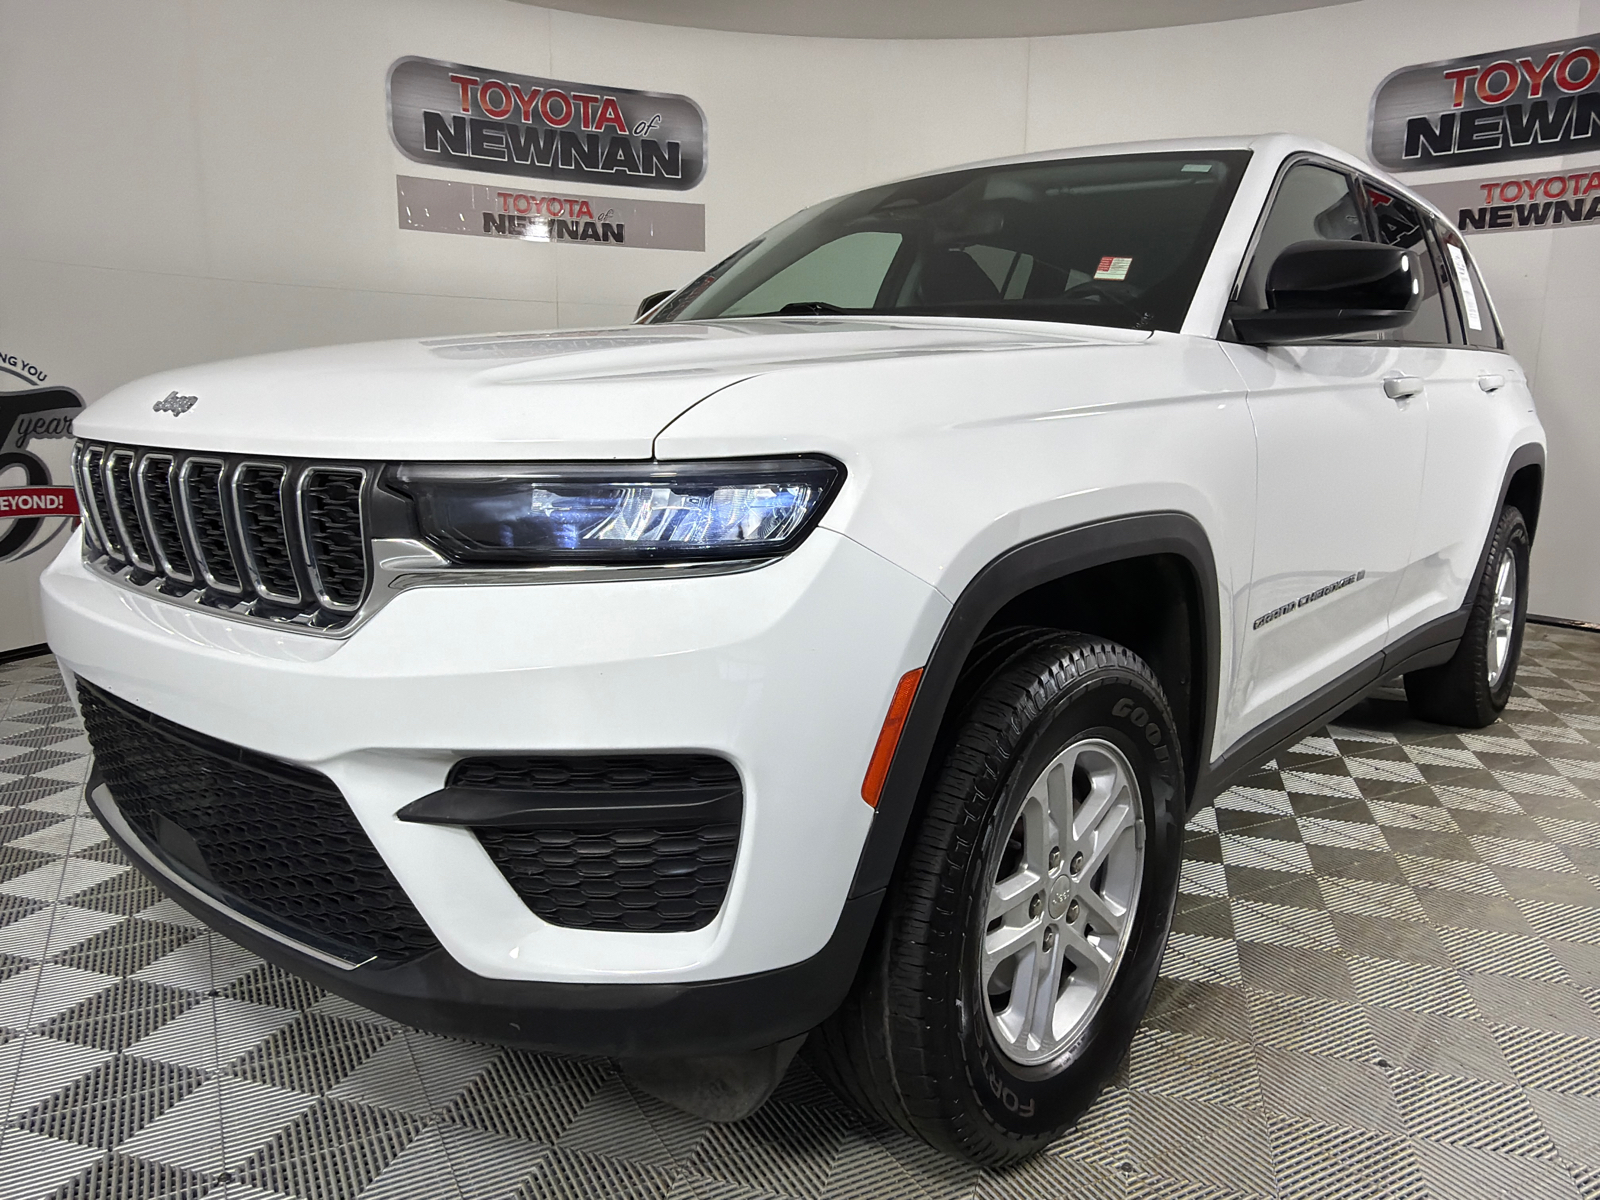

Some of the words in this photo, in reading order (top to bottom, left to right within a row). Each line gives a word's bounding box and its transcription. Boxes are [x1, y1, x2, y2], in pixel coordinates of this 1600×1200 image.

[449, 73, 629, 135] TOYOTA
[632, 114, 661, 136] of
[422, 110, 682, 178] NEWNAN
[497, 192, 594, 219] TOYOTA
[597, 209, 614, 222] of
[482, 212, 625, 243] NENAN
[21, 359, 48, 382] YOU
[152, 390, 199, 418] Jeep
